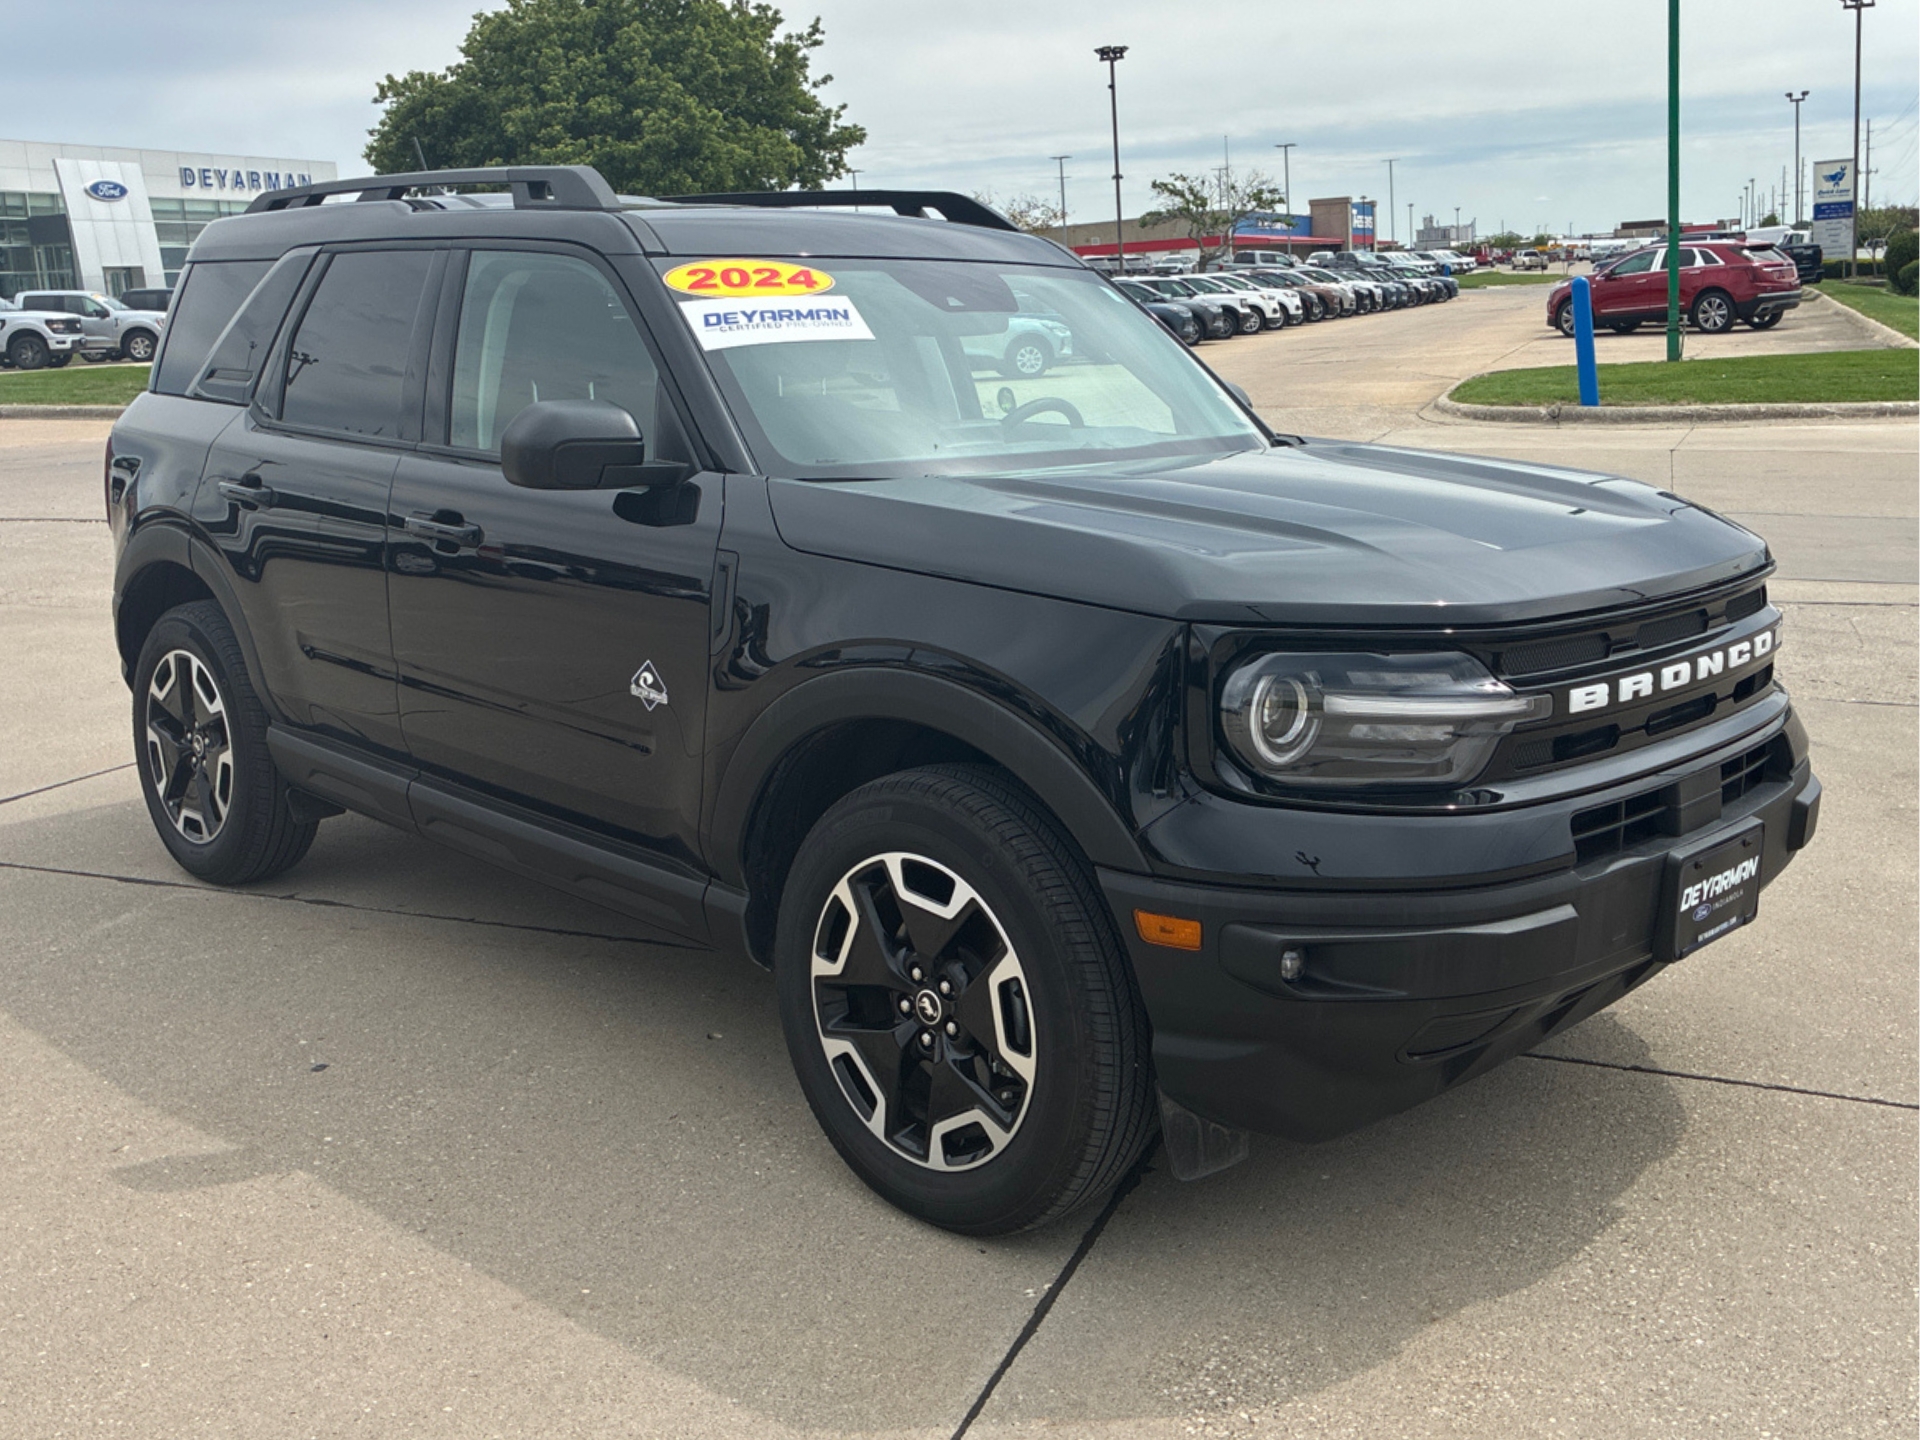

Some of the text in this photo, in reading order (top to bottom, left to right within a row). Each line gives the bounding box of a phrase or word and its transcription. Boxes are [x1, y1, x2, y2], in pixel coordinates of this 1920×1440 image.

[180, 167, 312, 190] DEYARMAN
[686, 267, 819, 290] 2024
[703, 308, 850, 327] DEYARMAN
[719, 320, 853, 332] CERTIFIED PRE-OWNED
[1568, 630, 1775, 714] BRONCO
[1680, 855, 1759, 912] DEYARMAN
